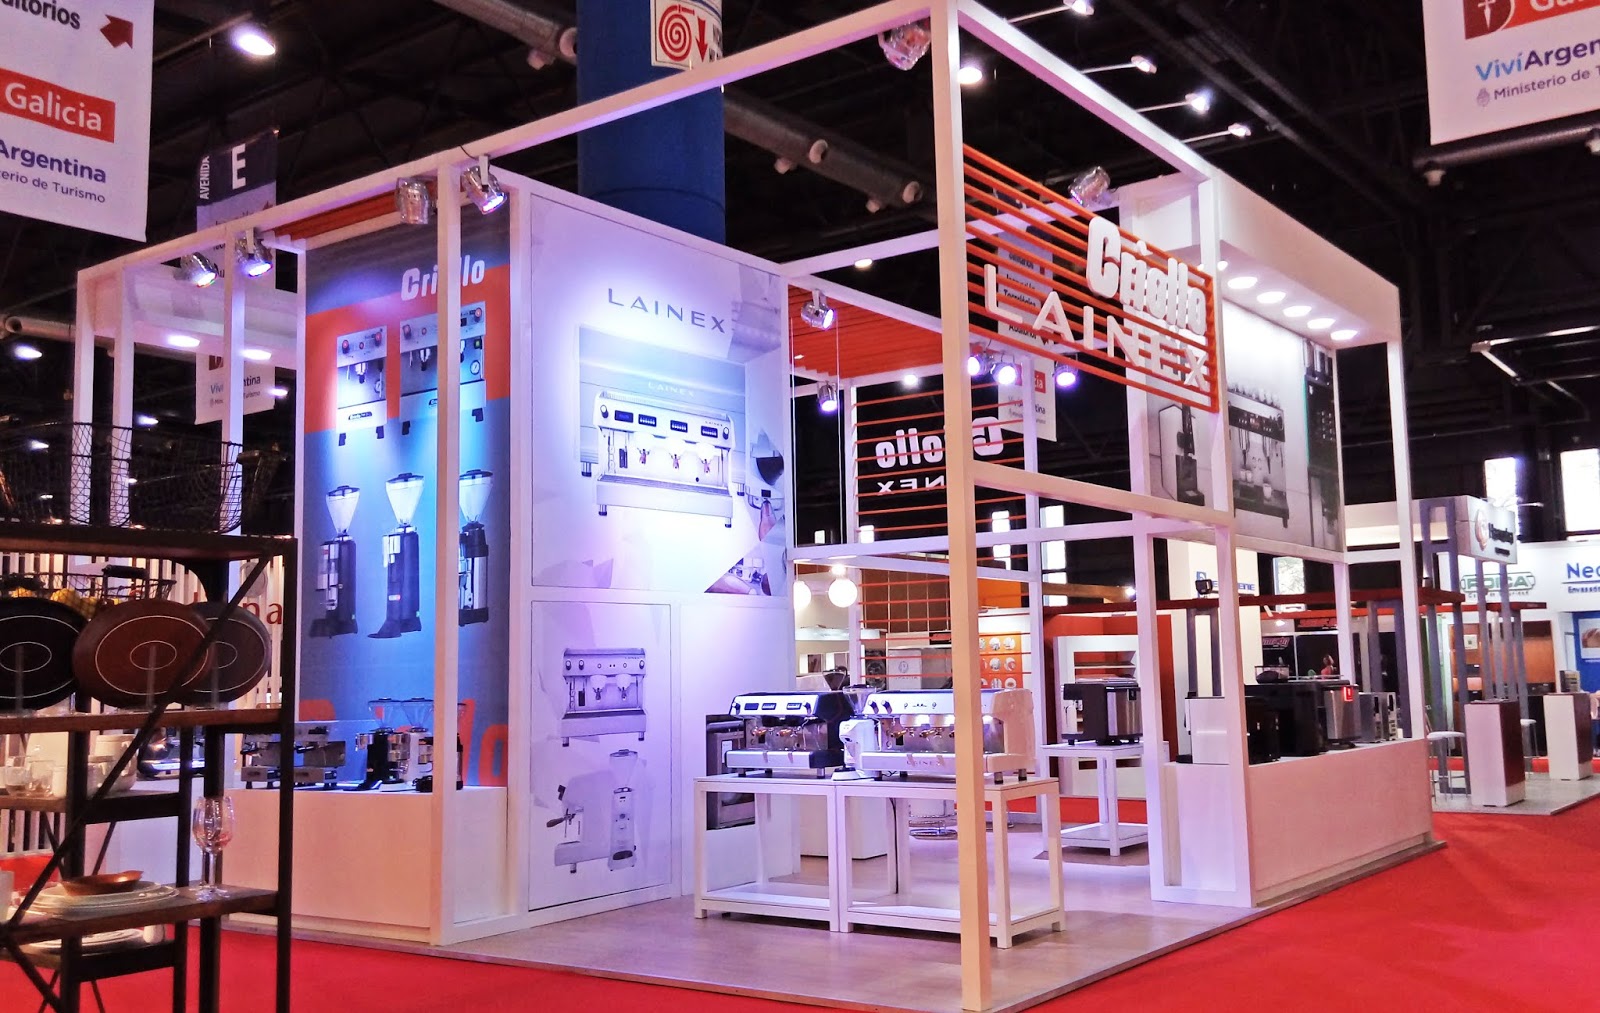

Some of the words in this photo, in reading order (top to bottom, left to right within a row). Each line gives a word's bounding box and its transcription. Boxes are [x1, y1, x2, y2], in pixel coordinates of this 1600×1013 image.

[0, 0, 80, 30] torios
[5, 82, 102, 132] Galicia
[1494, 74, 1566, 100] Ministerio
[1571, 69, 1590, 82] de
[199, 155, 210, 200] AVENIDA
[231, 143, 247, 190] E
[32, 177, 48, 190] de
[52, 181, 106, 204] Turismo
[401, 254, 486, 301] Crilo
[1086, 215, 1207, 336] Criollo
[607, 287, 726, 334] LAINEX
[983, 263, 1208, 388] LAINEX
